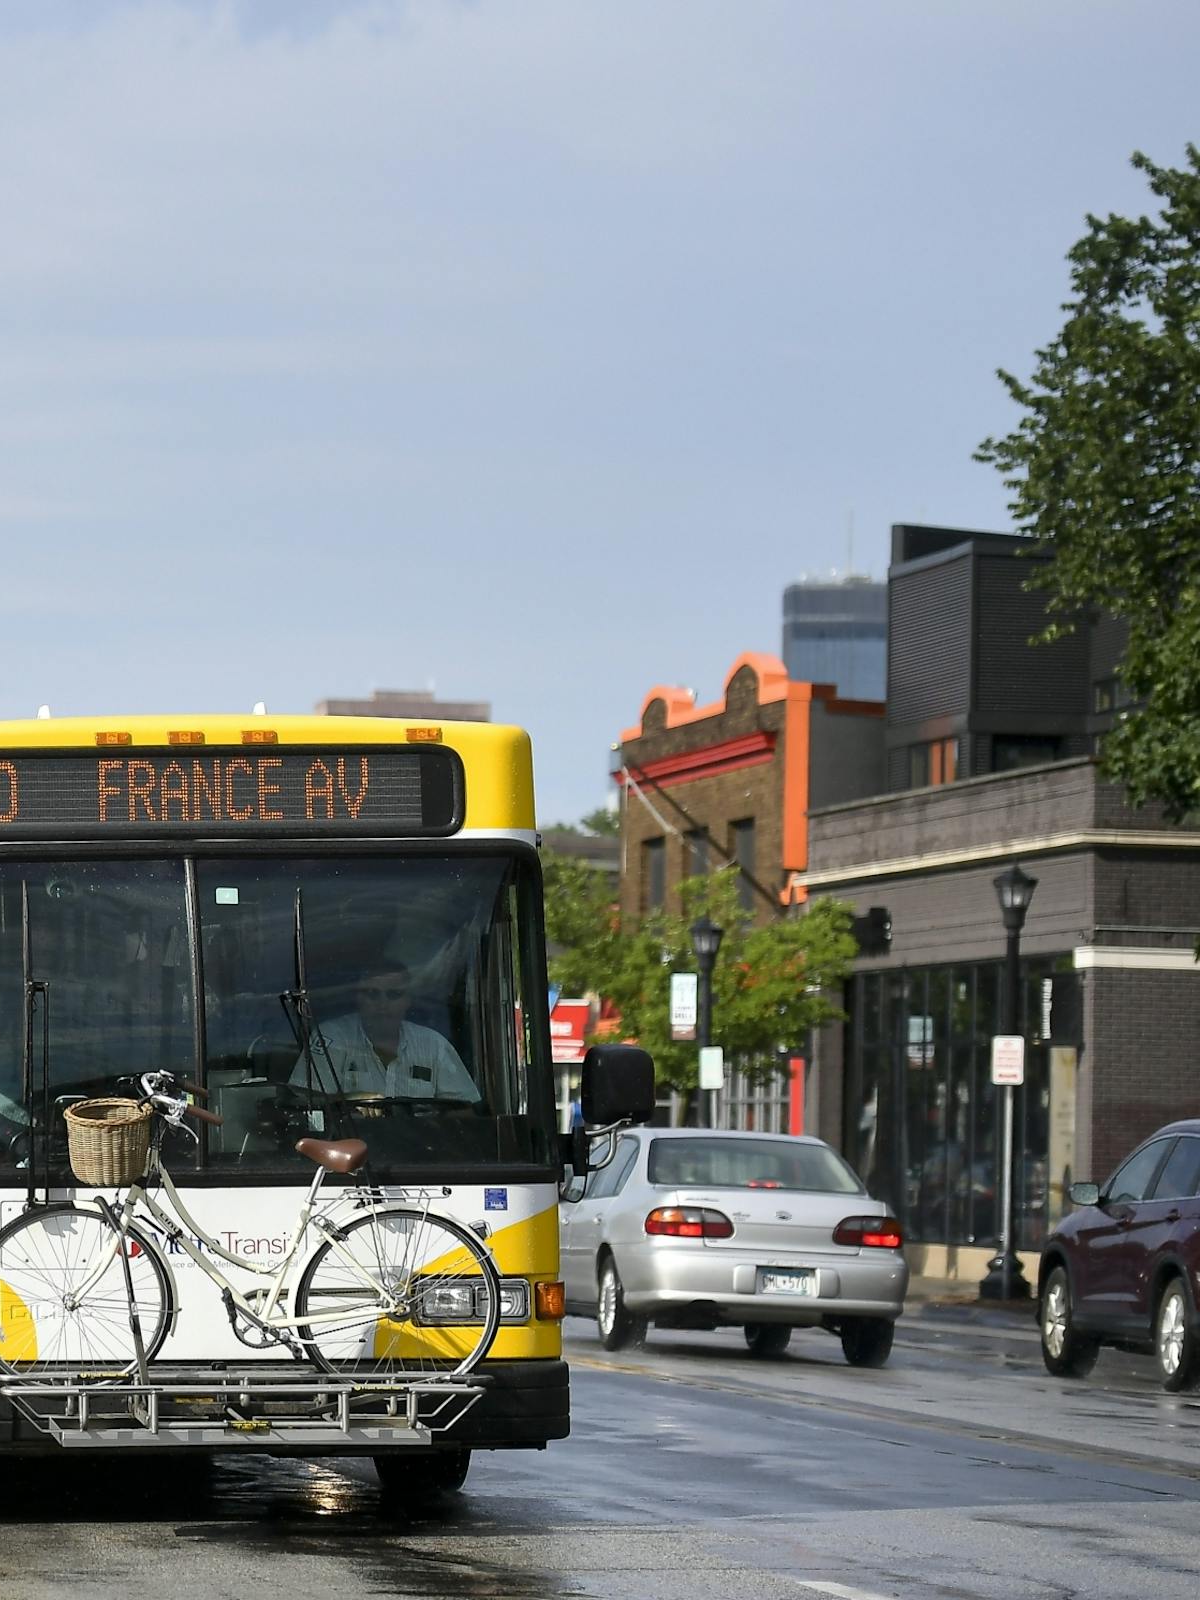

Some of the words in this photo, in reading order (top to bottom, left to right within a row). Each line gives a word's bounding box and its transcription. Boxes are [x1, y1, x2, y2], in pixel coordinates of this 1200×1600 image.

[98, 758, 284, 822] FRANCE
[305, 757, 369, 819] AV
[220, 1231, 292, 1255] Transi
